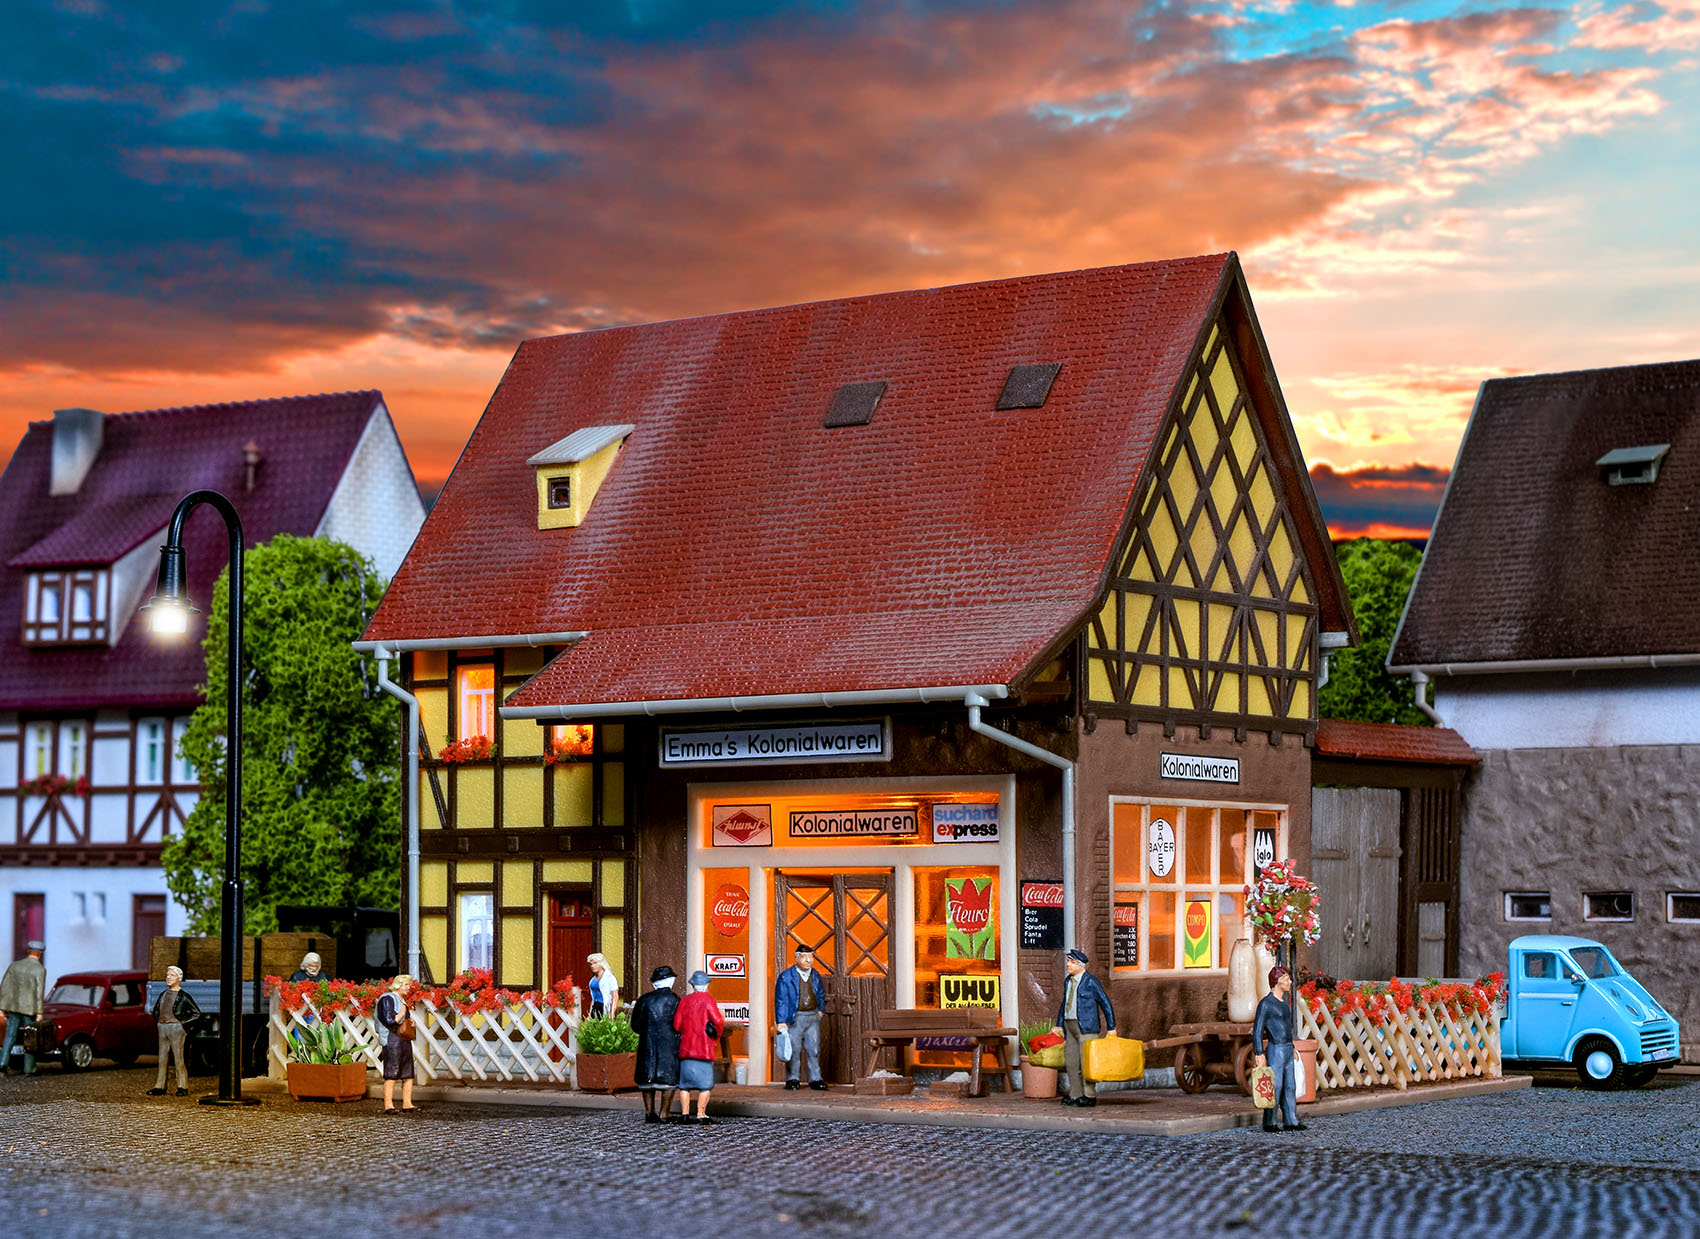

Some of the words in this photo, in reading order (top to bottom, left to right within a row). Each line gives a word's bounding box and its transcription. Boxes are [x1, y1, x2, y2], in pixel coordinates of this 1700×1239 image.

[669, 734, 737, 757] Emma's
[748, 731, 879, 754] Kolonialwaren
[1162, 757, 1237, 780] Kolonialwaren
[935, 804, 998, 822] suchard
[792, 813, 914, 833] Kolonialwaren
[936, 823, 998, 840] express
[1256, 848, 1271, 864] iglo
[1187, 914, 1206, 926] COMPO
[944, 980, 995, 1002] UHU
